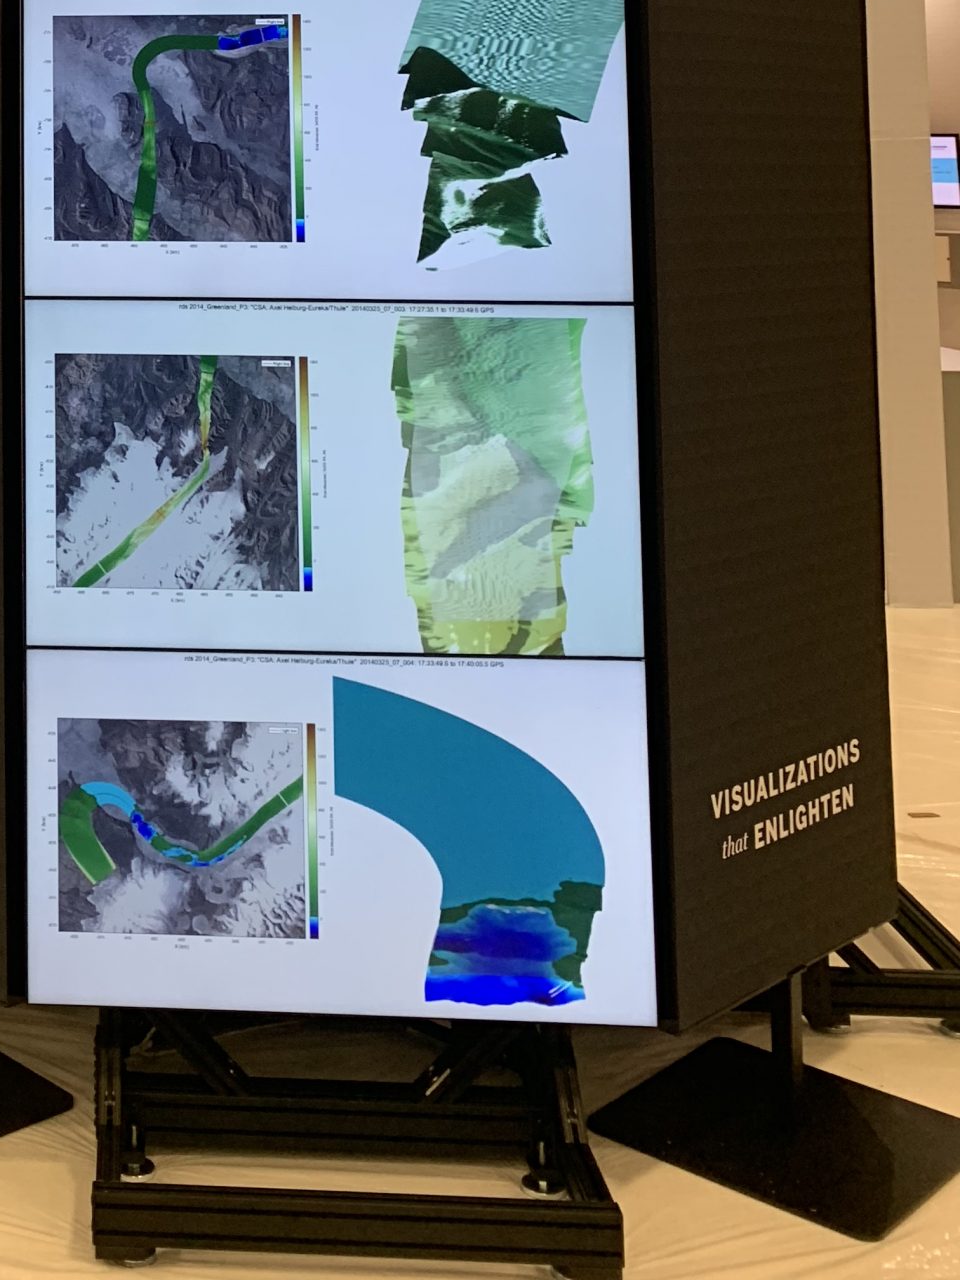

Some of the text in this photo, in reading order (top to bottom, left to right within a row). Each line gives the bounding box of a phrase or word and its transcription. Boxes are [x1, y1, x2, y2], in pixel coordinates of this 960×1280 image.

[711, 738, 860, 819] VISUALIZATIONS
[722, 783, 854, 859] that ENLIGHTEN
